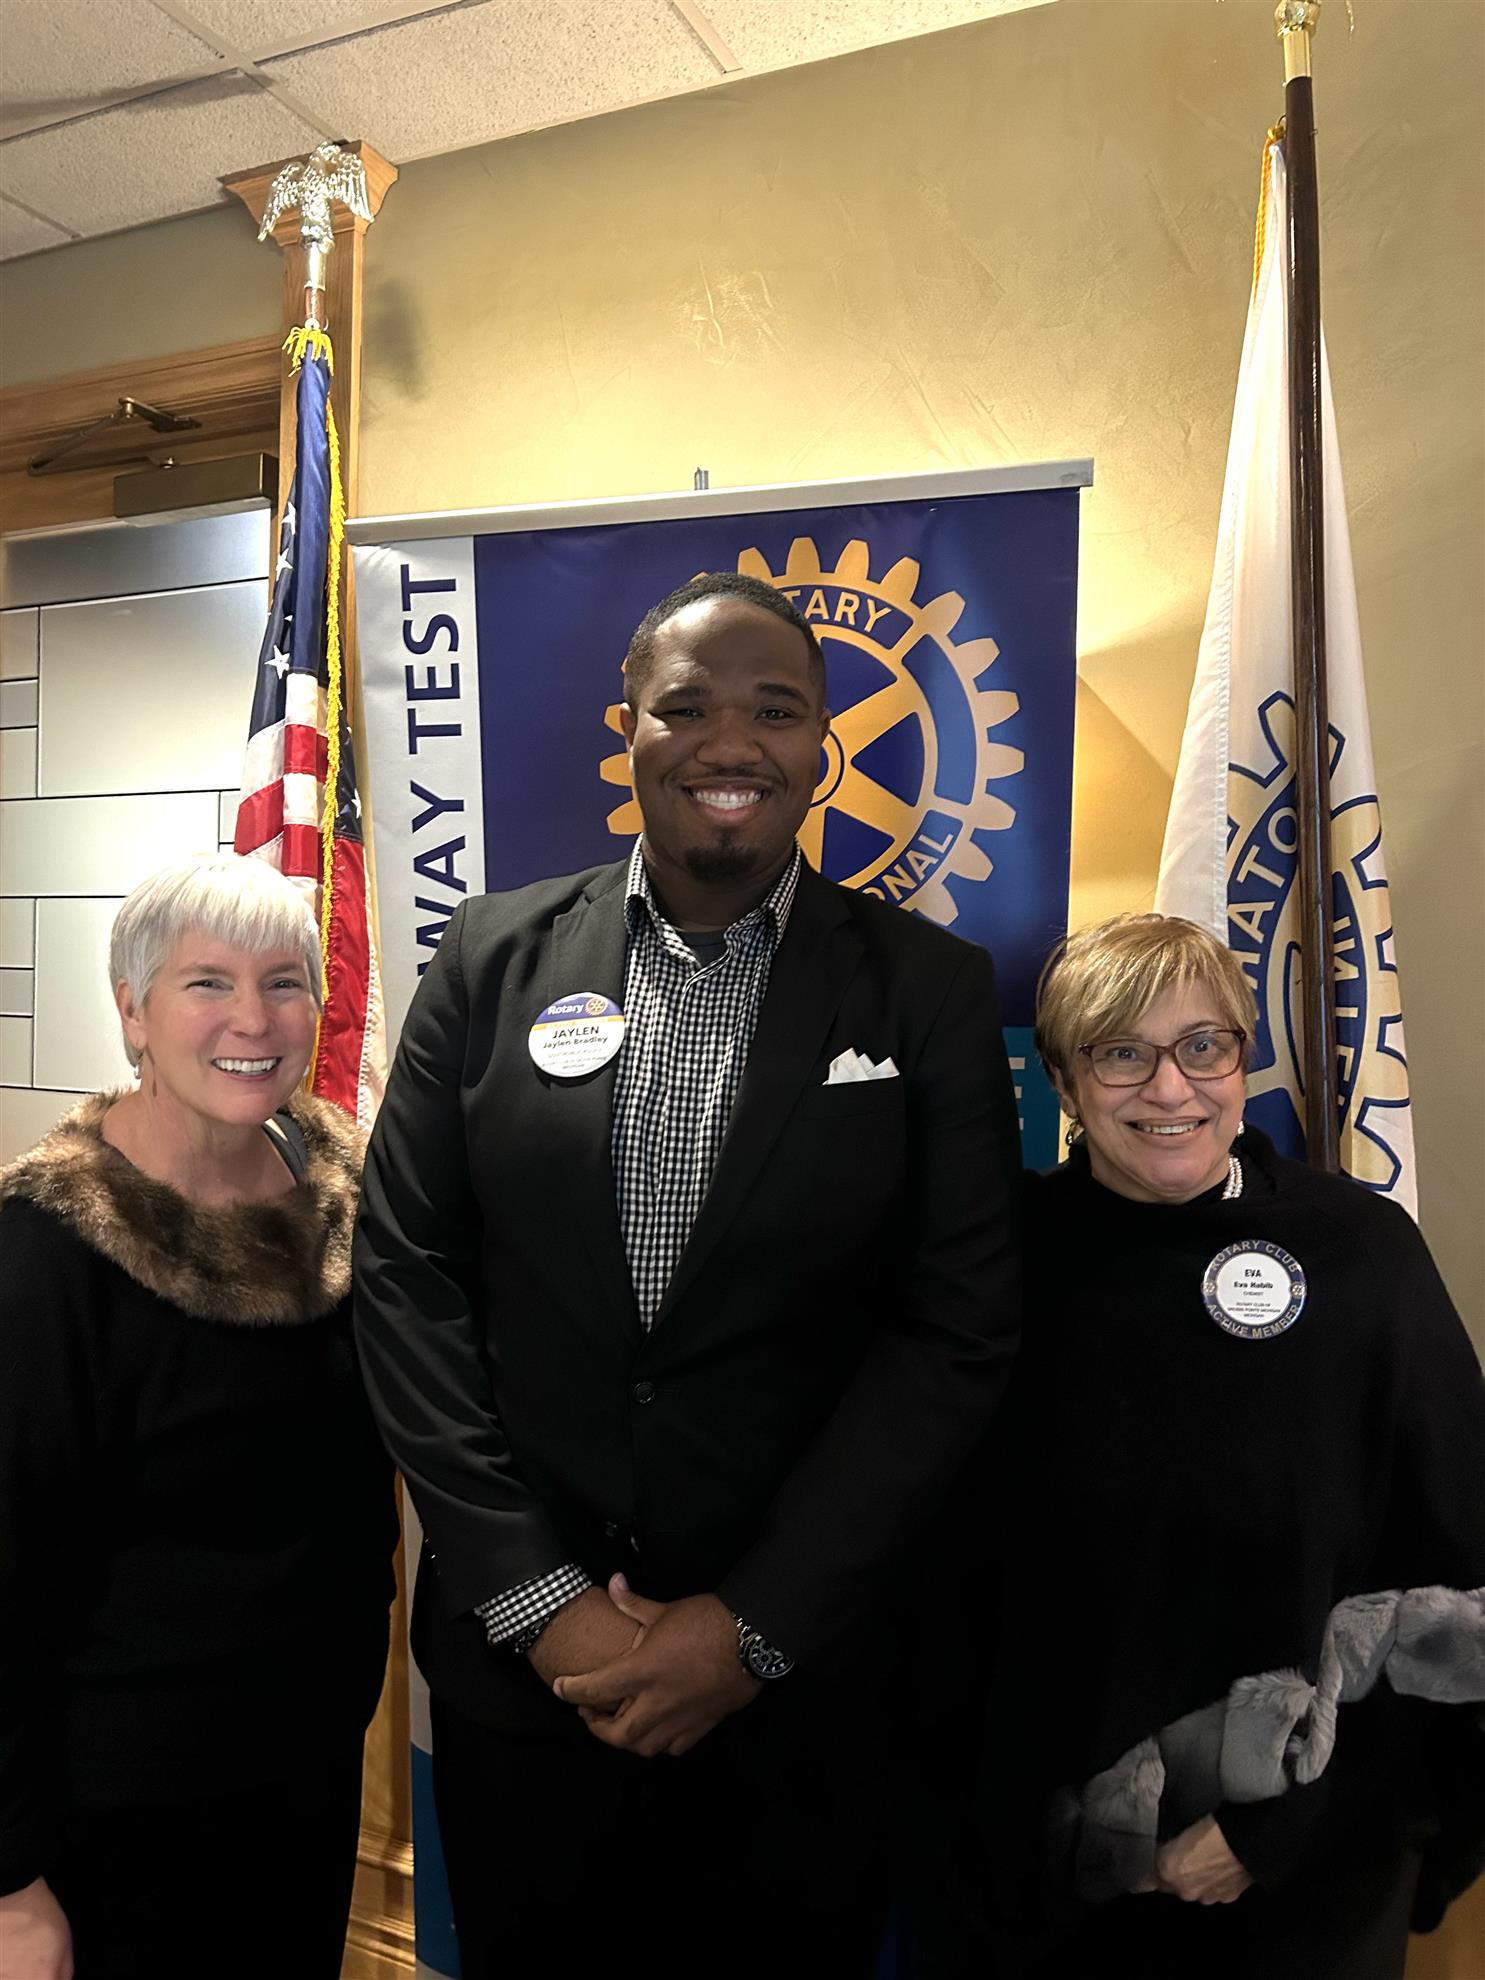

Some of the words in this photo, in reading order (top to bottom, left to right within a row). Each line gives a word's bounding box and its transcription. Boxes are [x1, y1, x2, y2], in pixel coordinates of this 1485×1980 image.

[400, 563, 463, 755] TEST
[547, 1004, 585, 1016] Rotary
[552, 1026, 600, 1039] JAYLEN
[543, 1040, 572, 1049] Jaylen
[573, 1036, 608, 1046] Bradley
[1211, 1240, 1261, 1271] ROTARY
[1265, 1243, 1301, 1273] CLUB
[1244, 1268, 1262, 1278] EVA
[1233, 1280, 1248, 1288] Eva
[1207, 1304, 1249, 1335] ACTIVE
[1251, 1304, 1299, 1338] MEMBER
